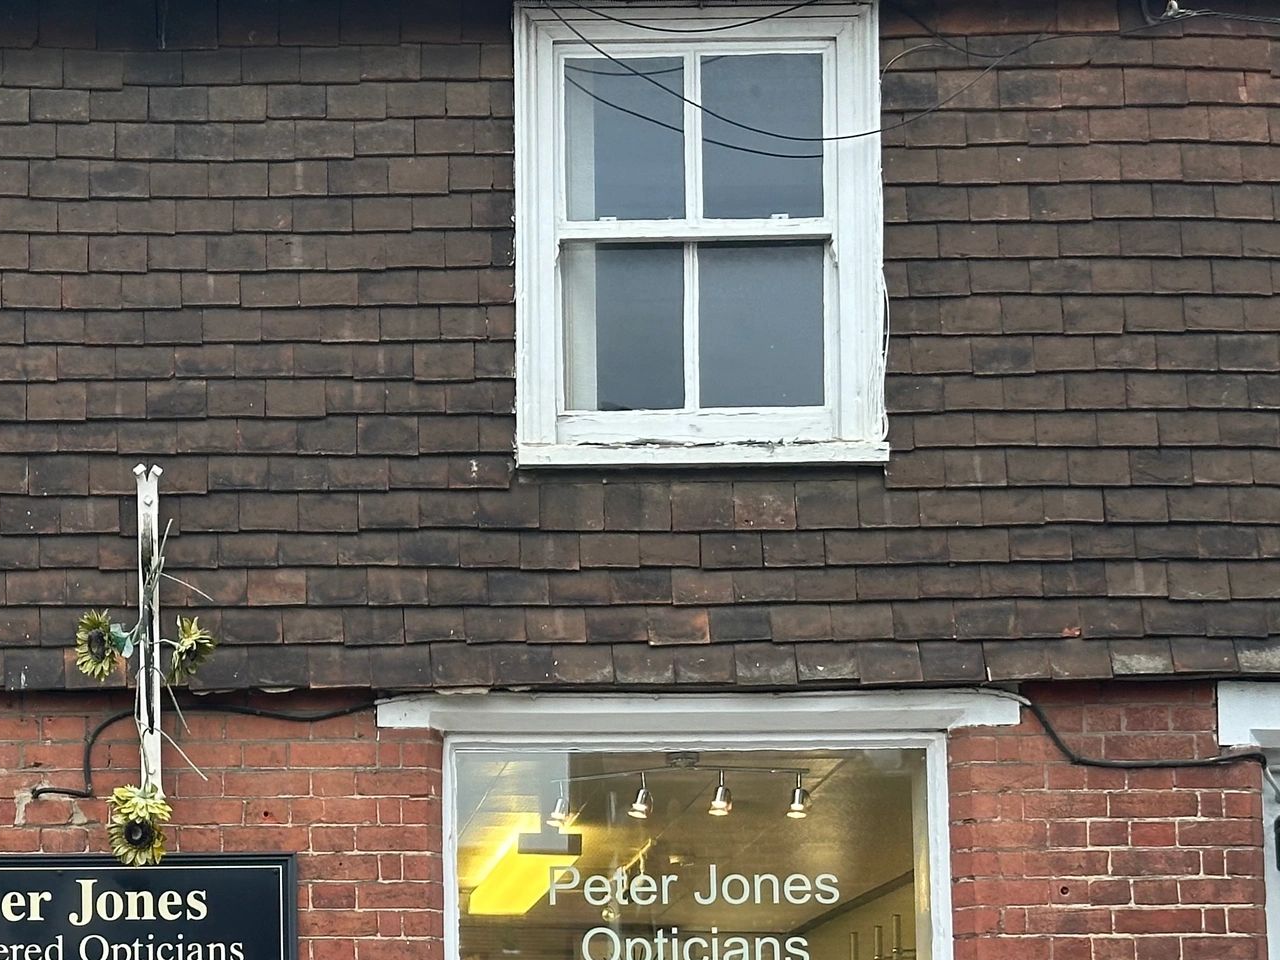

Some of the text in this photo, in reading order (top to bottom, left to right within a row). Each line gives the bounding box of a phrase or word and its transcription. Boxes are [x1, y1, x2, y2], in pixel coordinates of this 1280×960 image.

[68, 878, 208, 927] Jones
[549, 864, 840, 906] Peter Jones
